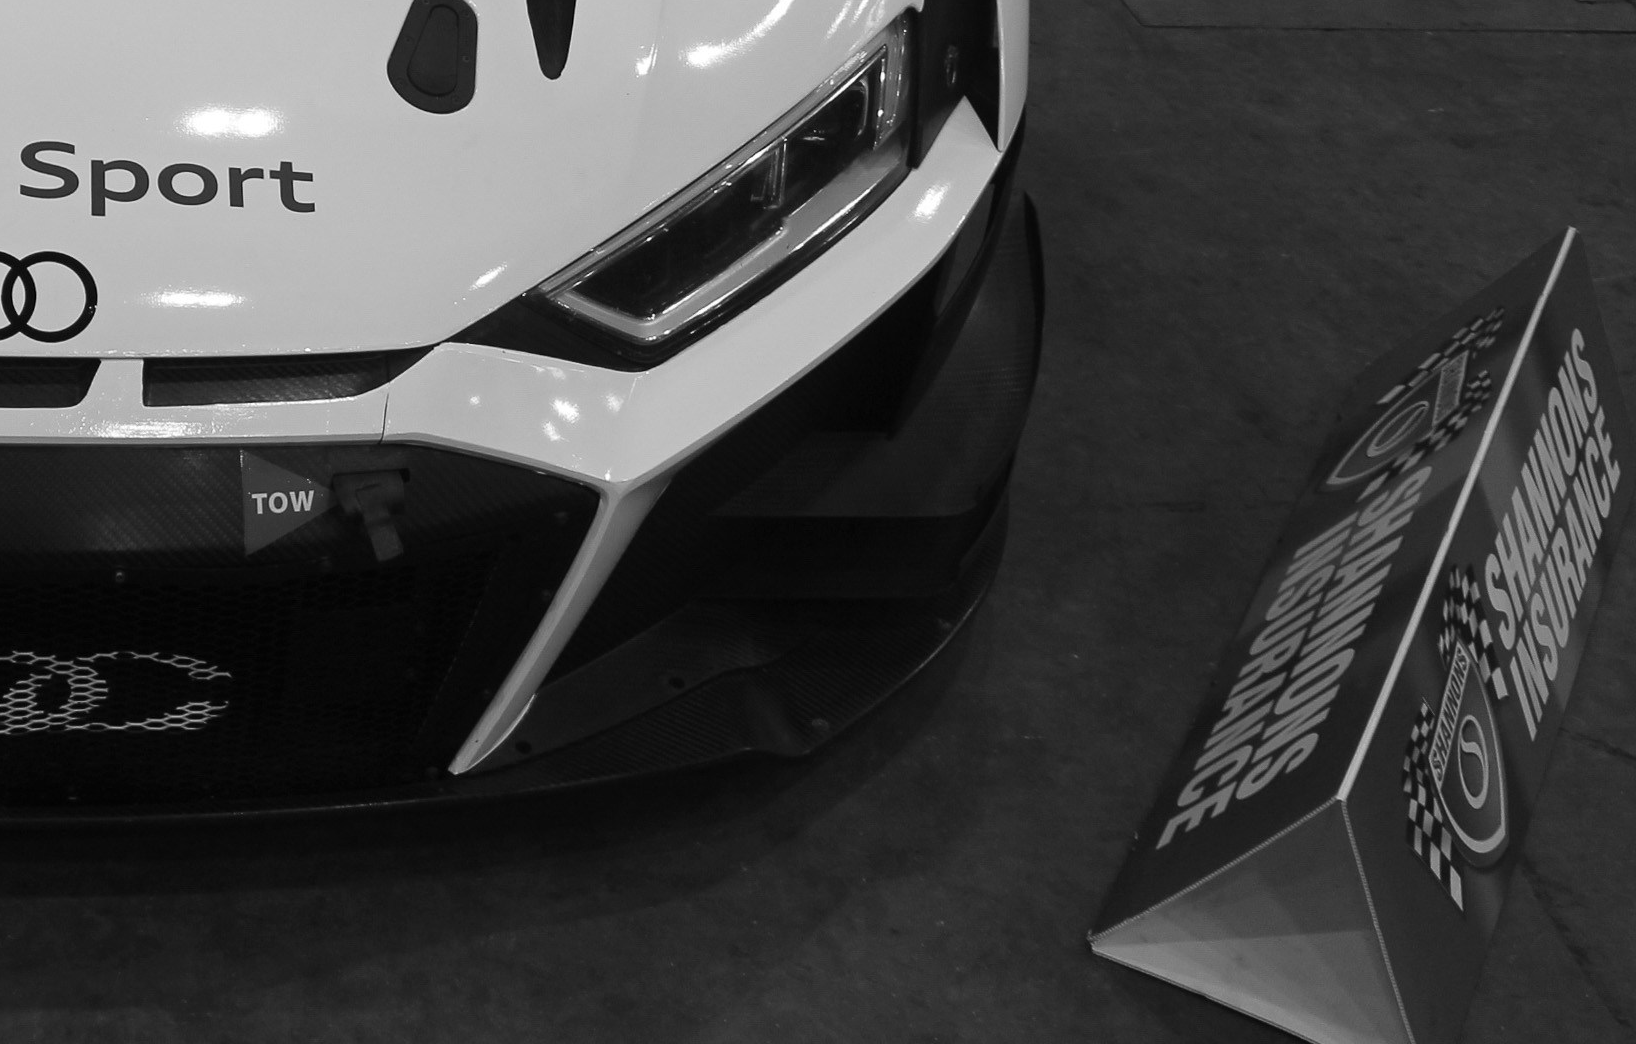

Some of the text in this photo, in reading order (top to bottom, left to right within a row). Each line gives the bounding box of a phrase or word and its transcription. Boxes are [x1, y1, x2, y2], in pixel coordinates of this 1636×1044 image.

[19, 141, 316, 217] Sport
[251, 490, 314, 515] TOW
[1236, 466, 1432, 800] SHANNONS
[1485, 328, 1598, 651] SHANNONS
[1510, 405, 1621, 742] INSURANCE
[1156, 512, 1358, 850] INSURANCE
[1432, 645, 1469, 782] SHANNONS
